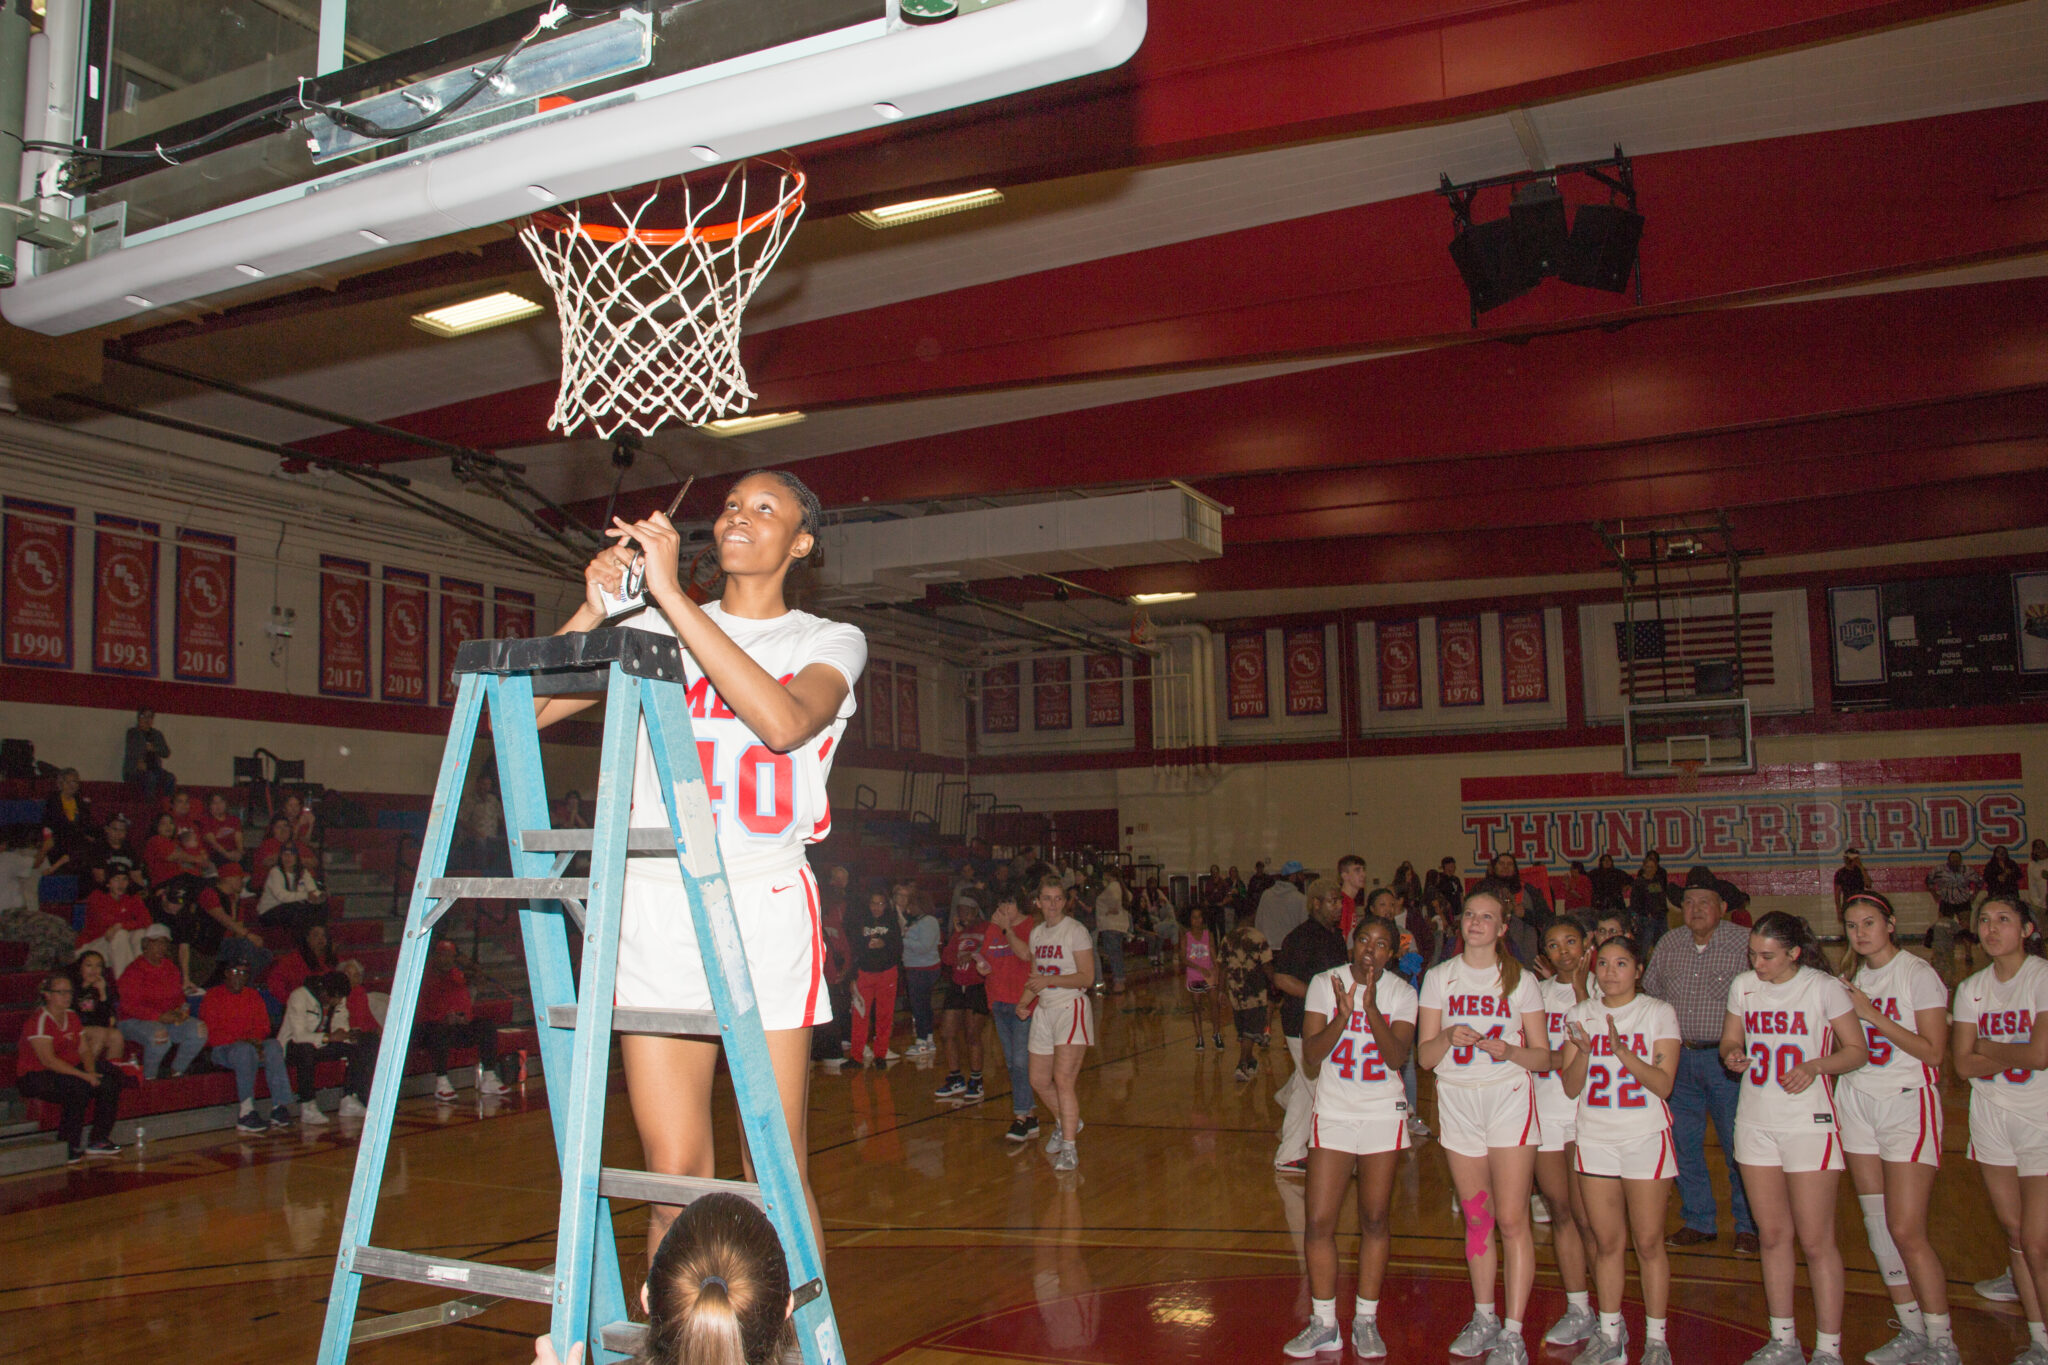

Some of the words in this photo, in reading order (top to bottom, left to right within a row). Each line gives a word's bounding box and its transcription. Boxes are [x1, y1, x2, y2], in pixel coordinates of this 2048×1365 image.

[12, 632, 63, 658] 1990
[1894, 640, 1920, 648] HOME
[1978, 633, 2009, 642] GUEST
[102, 641, 148, 668] 1993
[181, 650, 226, 674] 2016
[326, 667, 363, 689] 2017
[387, 674, 423, 695] 2019
[1384, 691, 1416, 704] 1974
[1447, 687, 1478, 701] 1976
[1510, 684, 1541, 698] 1987
[1234, 700, 1263, 713] 1970
[1292, 696, 1322, 710] 1973
[1092, 710, 1120, 722] 2022
[1463, 793, 2027, 865] THUNDERBIRDS
[1035, 944, 1064, 959] MESA
[1448, 994, 1512, 1019] MESA
[1744, 1010, 1809, 1036] MESA
[1978, 1009, 2033, 1036] MESA
[1330, 1037, 1388, 1083] 42
[1750, 1041, 1806, 1091] 30
[1587, 1063, 1649, 1109] 22
